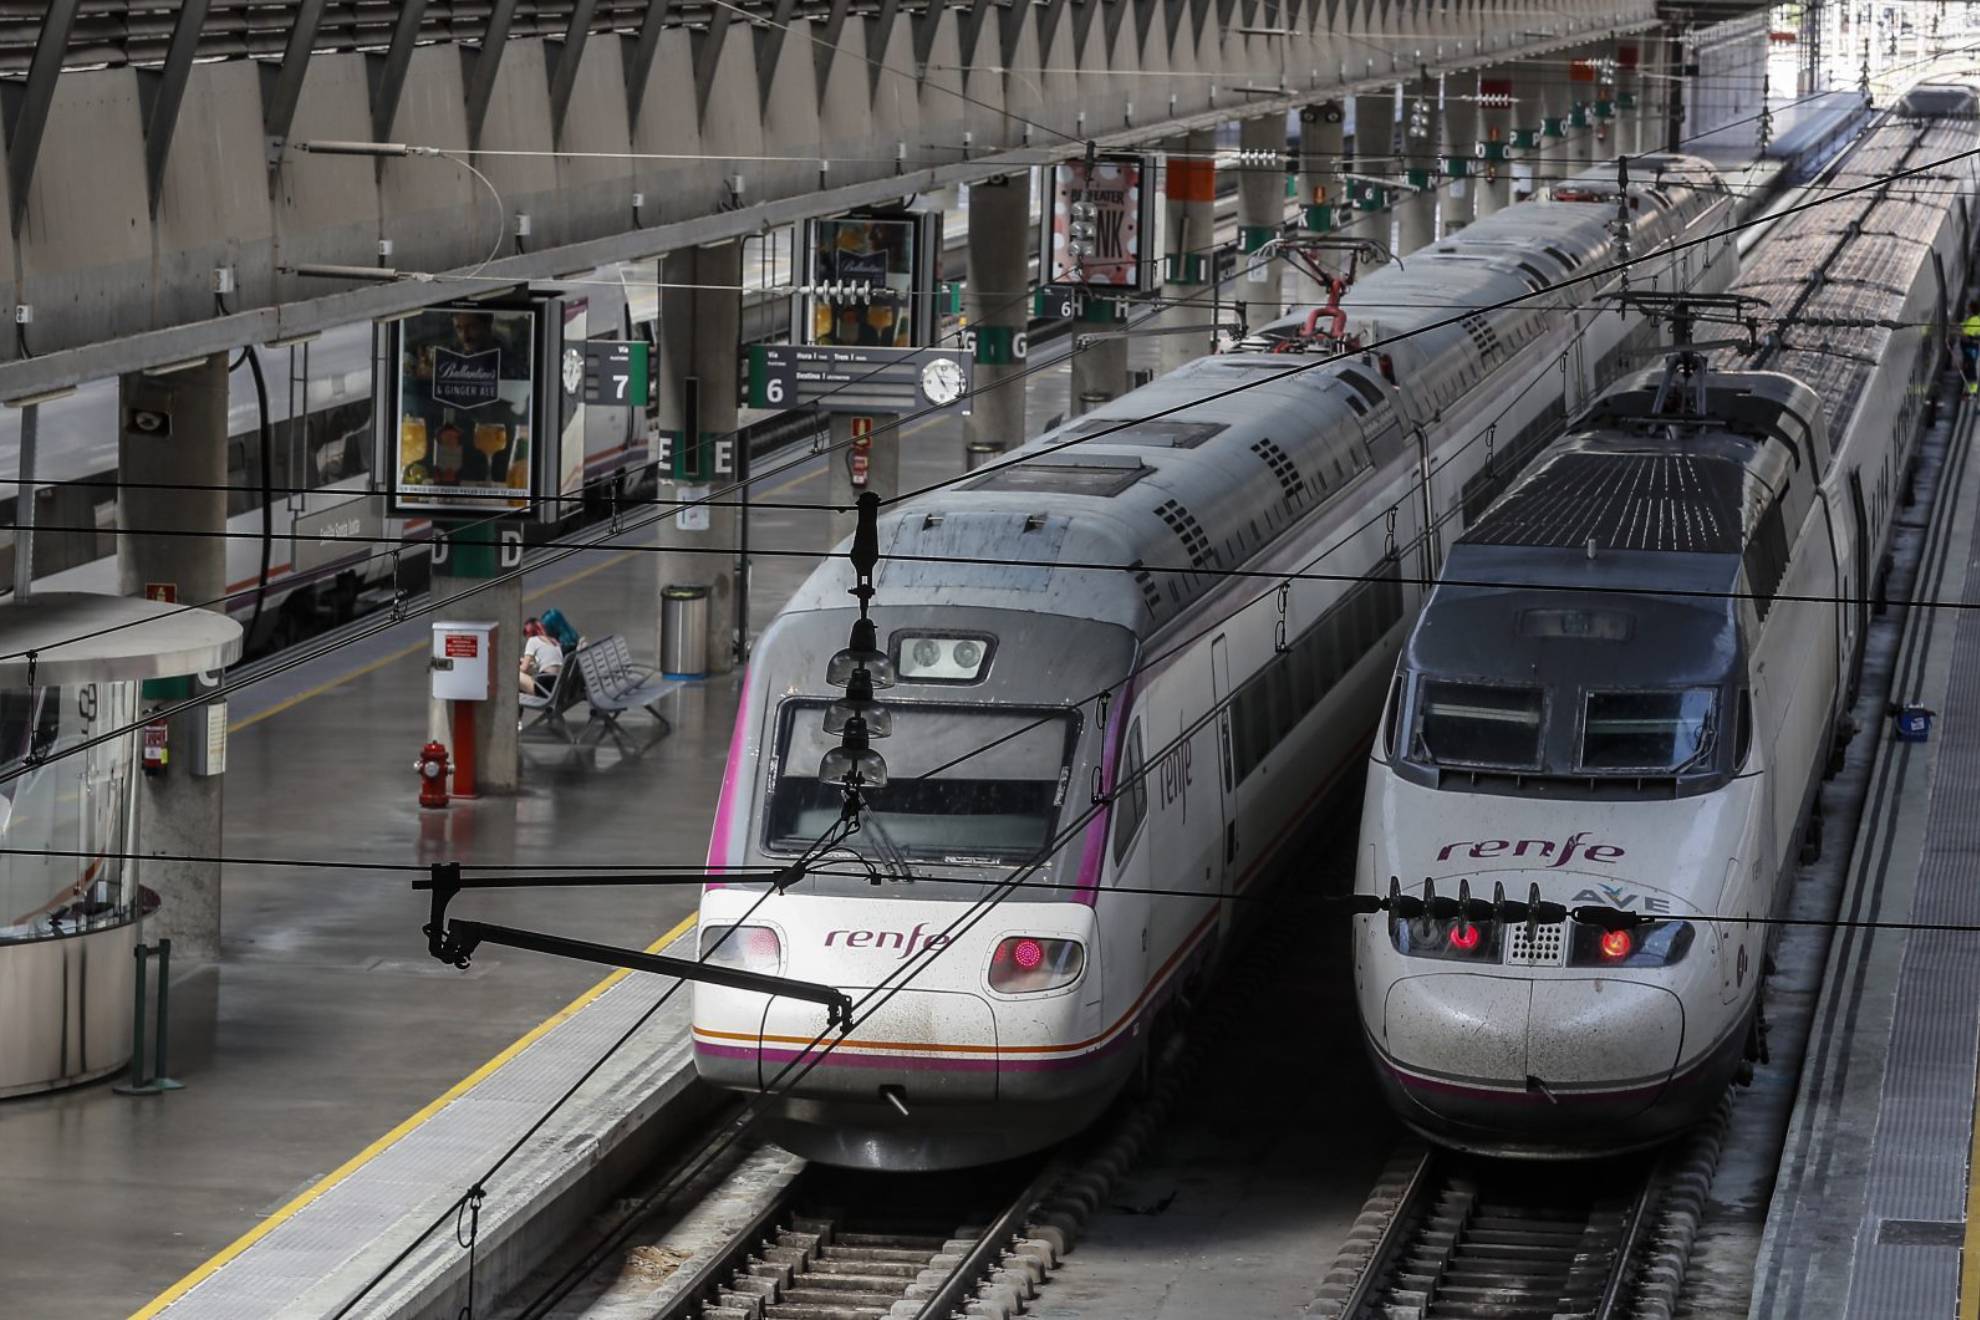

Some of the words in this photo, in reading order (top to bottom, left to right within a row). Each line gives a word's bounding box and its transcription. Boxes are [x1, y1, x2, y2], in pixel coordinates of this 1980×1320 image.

[1509, 131, 1517, 144] P
[1532, 133, 1541, 147] P
[1466, 160, 1476, 175] N
[1365, 188, 1373, 200] 6
[1331, 209, 1341, 227] K
[1060, 301, 1072, 318] 6
[1115, 294, 1129, 318] H
[1012, 332, 1027, 358] G
[444, 384, 478, 397] GINGER
[479, 384, 496, 398] ALE
[612, 375, 629, 399] 7
[766, 378, 784, 403] 6
[658, 437, 672, 471] E
[715, 441, 733, 473] E
[431, 528, 448, 564] D
[501, 530, 523, 567] D
[1160, 715, 1193, 825] renfe
[1436, 831, 1626, 868] renfe
[1571, 886, 1671, 915] AVE
[824, 921, 951, 960] renfe
